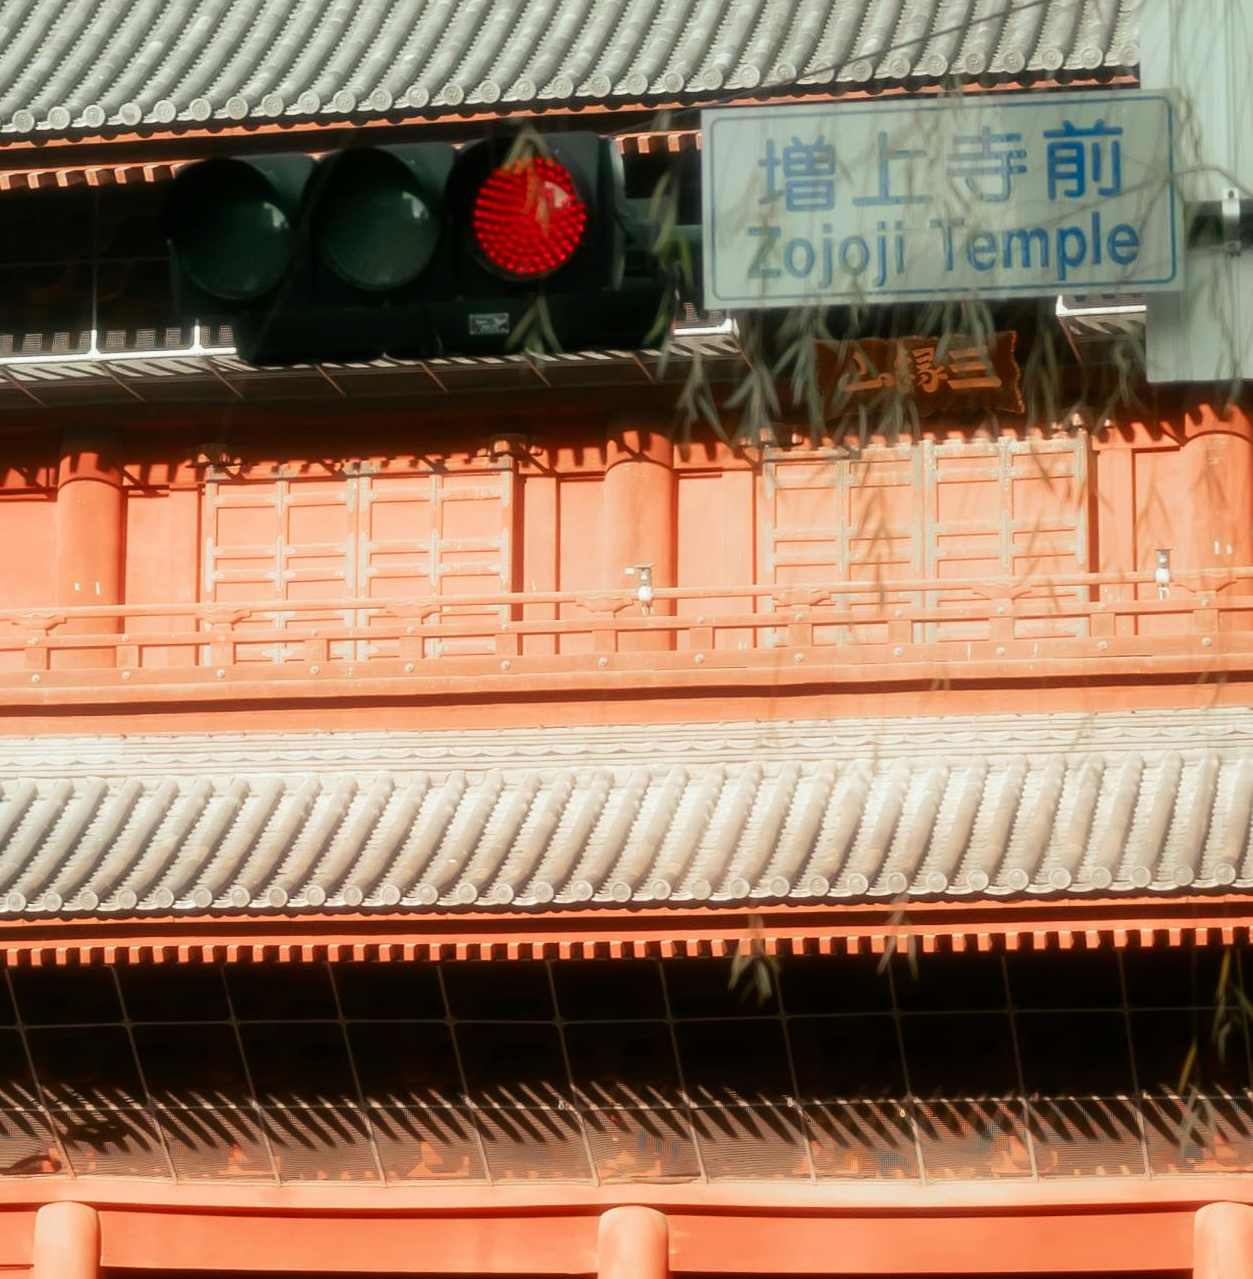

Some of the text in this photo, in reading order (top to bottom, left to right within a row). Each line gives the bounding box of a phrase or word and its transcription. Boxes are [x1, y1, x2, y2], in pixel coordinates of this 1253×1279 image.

[757, 119, 1125, 212] 増上寺前
[746, 212, 1141, 289] Zojoji Temple
